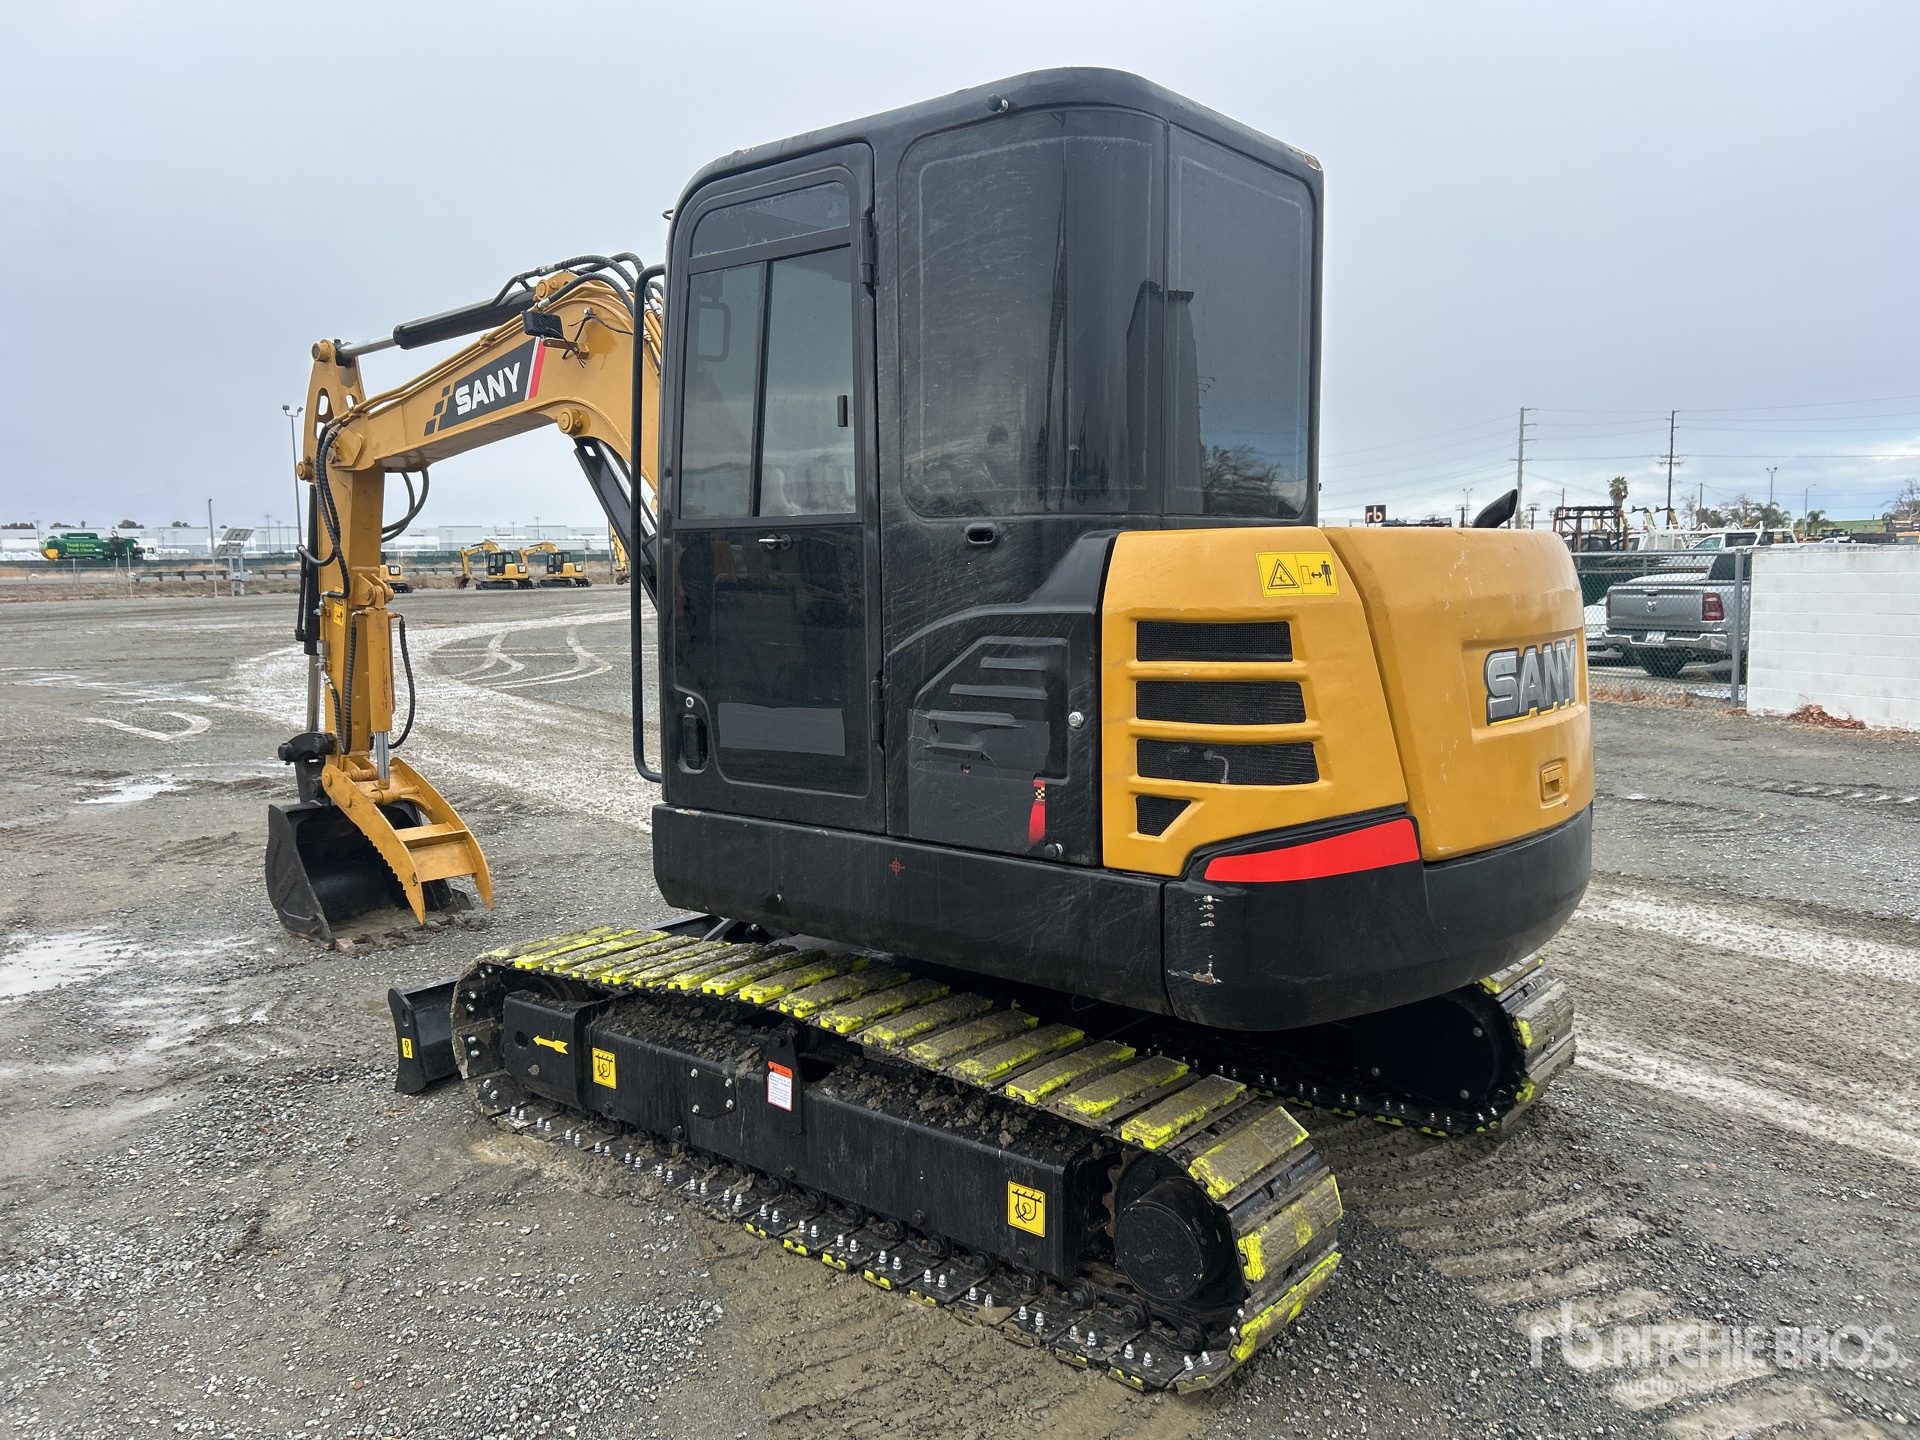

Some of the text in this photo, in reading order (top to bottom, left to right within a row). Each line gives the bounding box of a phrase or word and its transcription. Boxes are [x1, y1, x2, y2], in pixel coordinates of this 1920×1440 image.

[454, 361, 521, 416] SANY
[1366, 506, 1383, 523] rb
[1484, 639, 1576, 726] SANY
